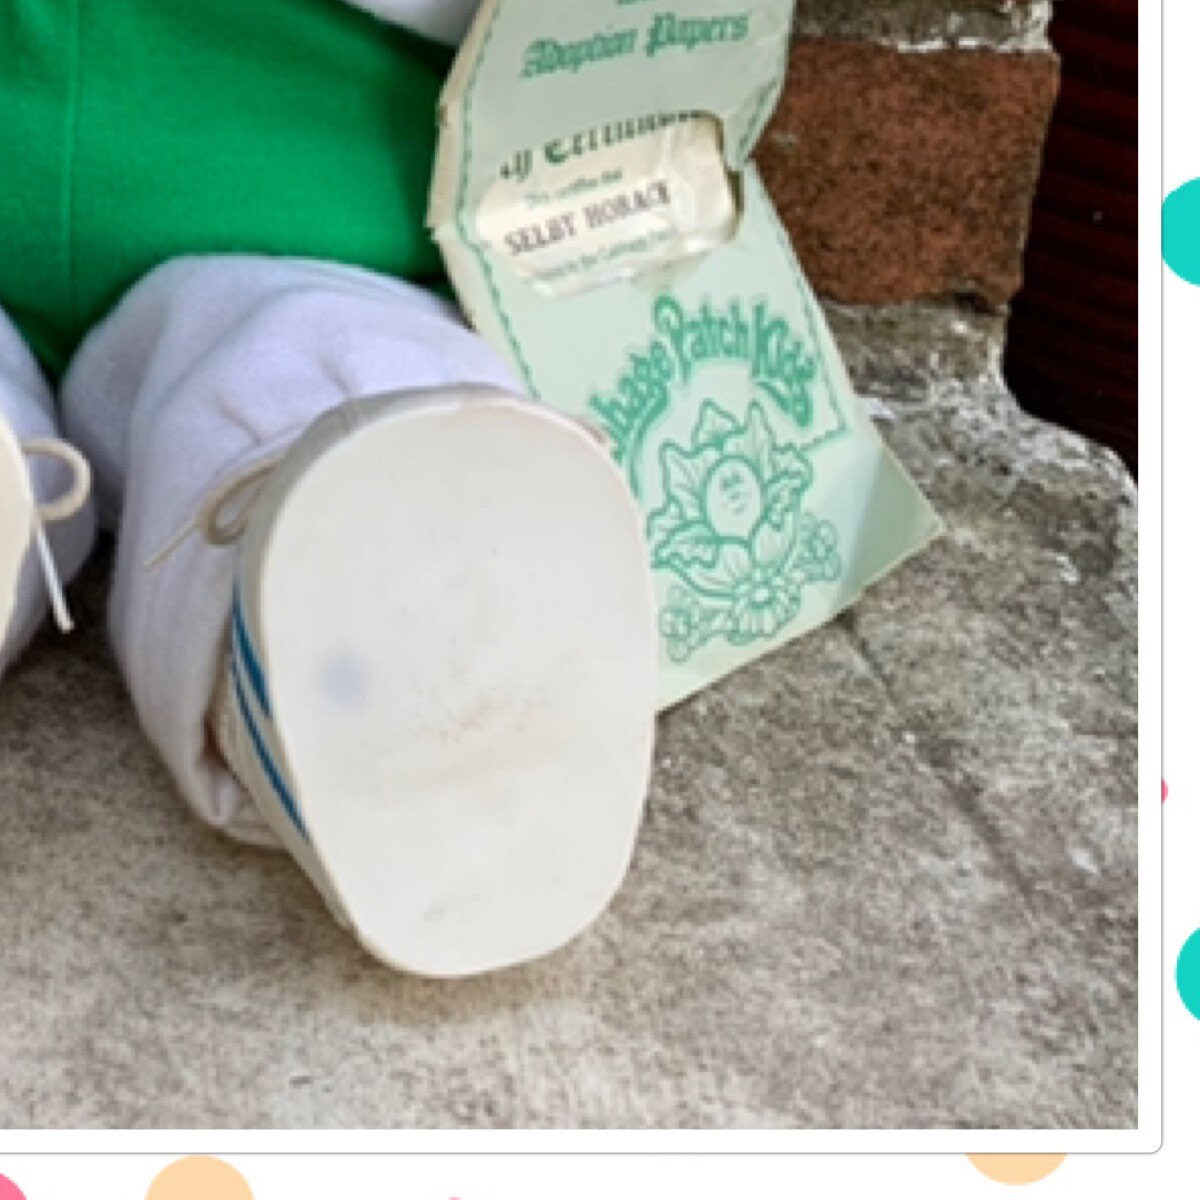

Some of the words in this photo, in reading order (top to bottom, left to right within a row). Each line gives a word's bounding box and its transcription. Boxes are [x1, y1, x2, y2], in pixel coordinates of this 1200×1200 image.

[518, 25, 638, 79] Adoption
[645, 11, 750, 58] Papers
[503, 211, 577, 257] SELBY
[653, 295, 750, 385] Patch
[751, 303, 817, 428] Kids
